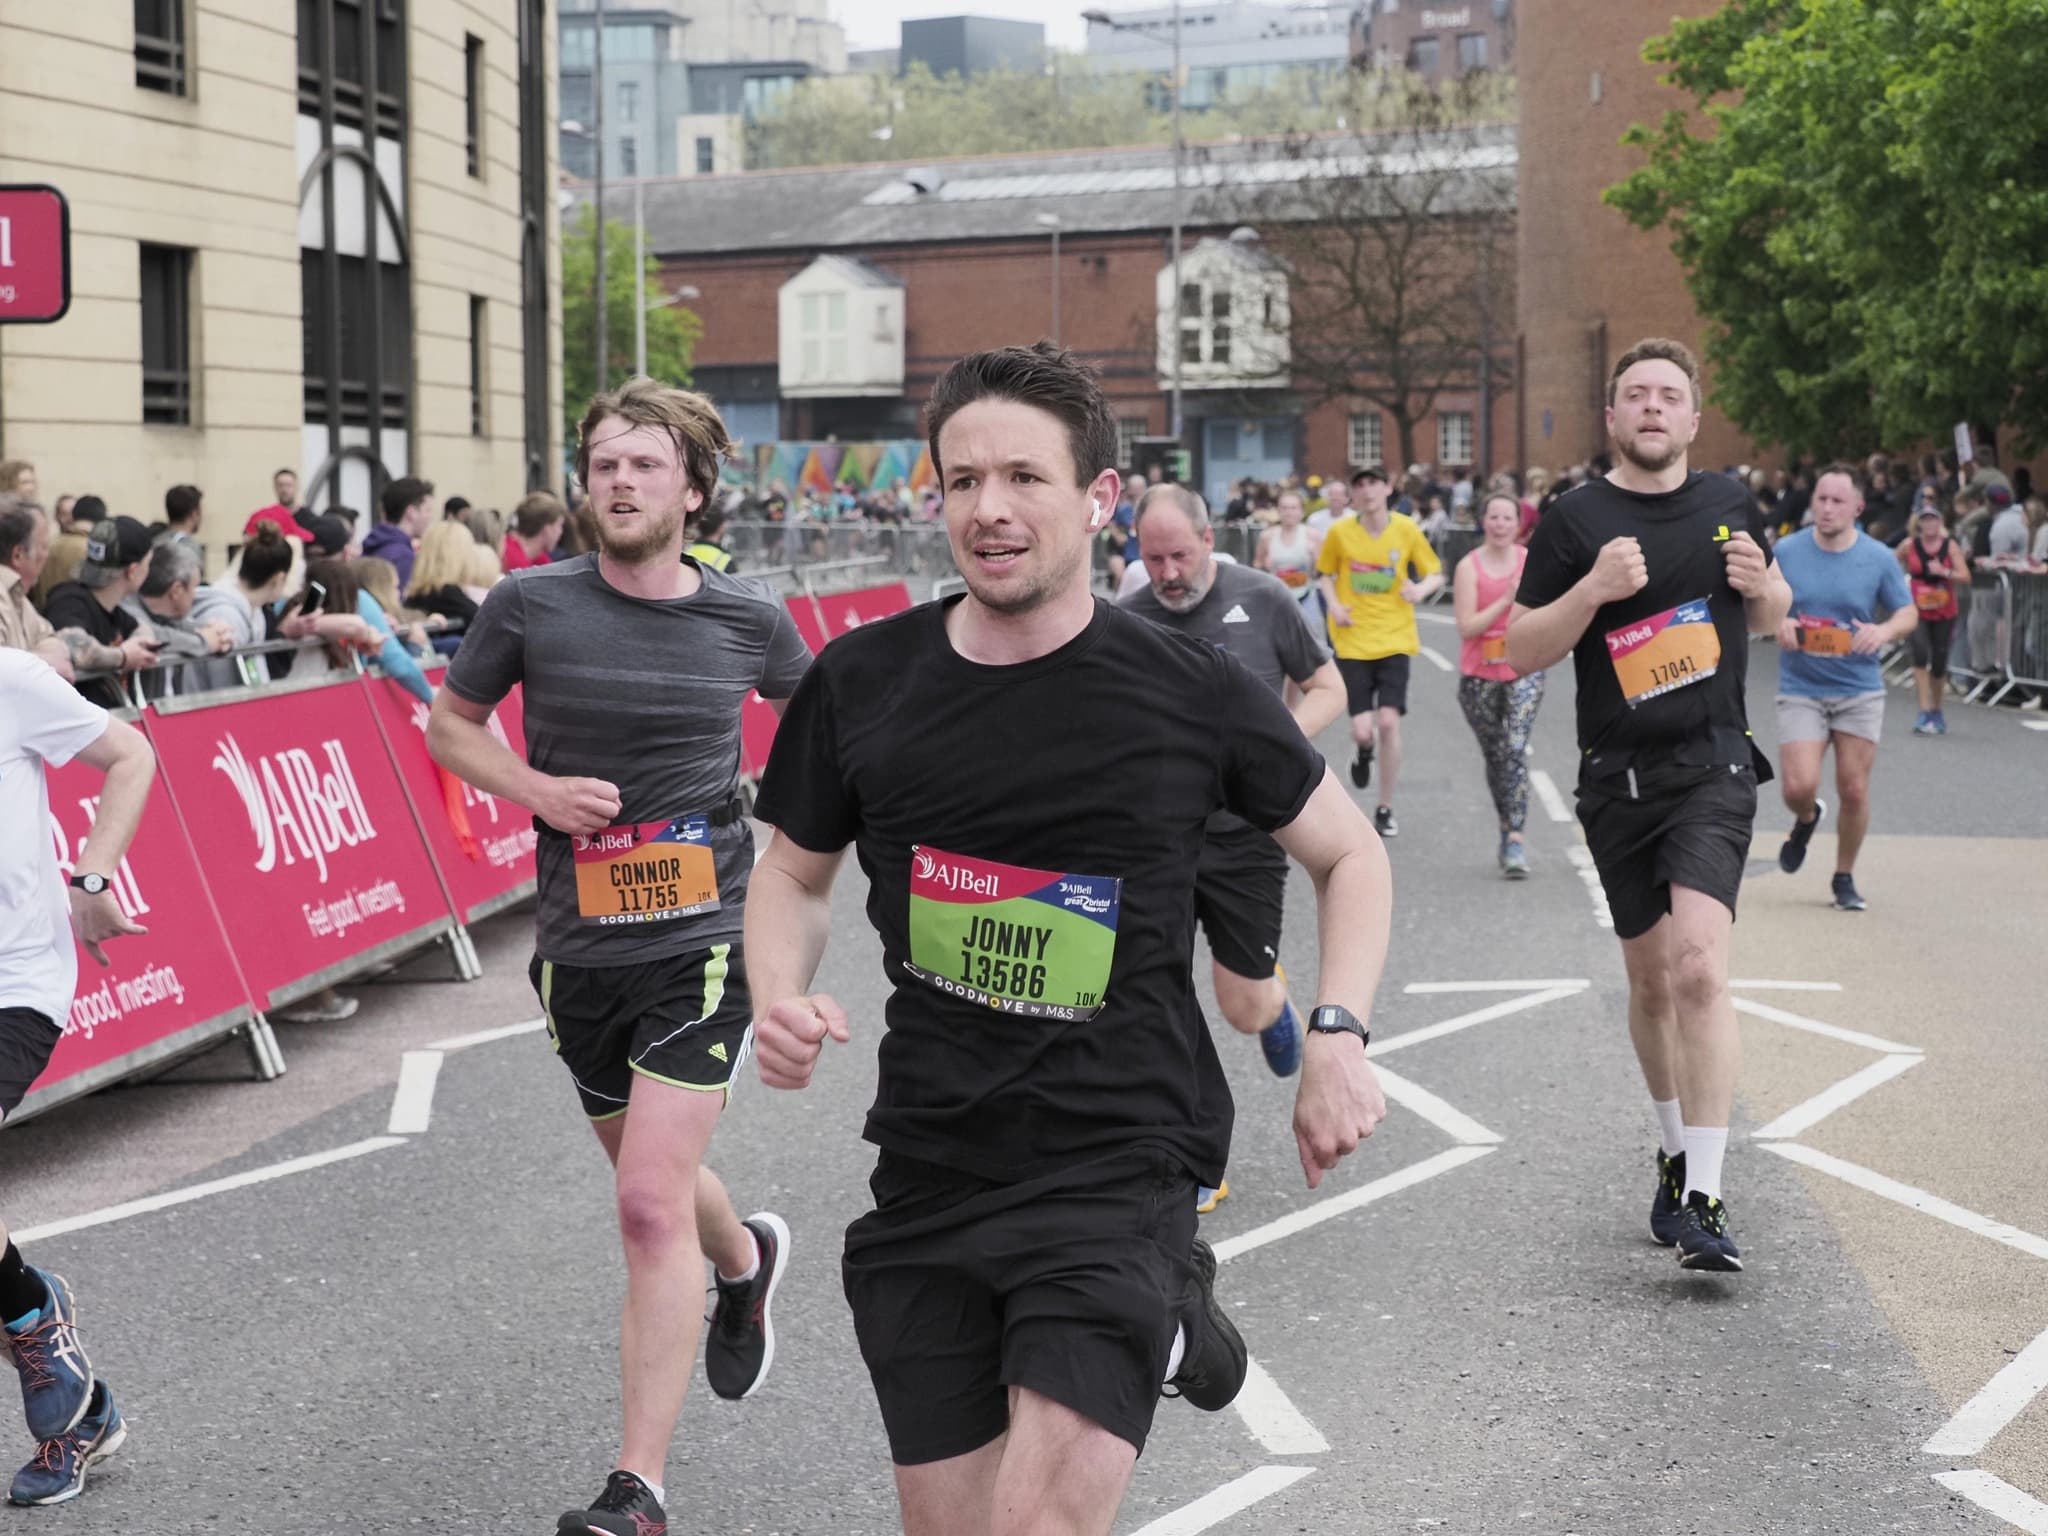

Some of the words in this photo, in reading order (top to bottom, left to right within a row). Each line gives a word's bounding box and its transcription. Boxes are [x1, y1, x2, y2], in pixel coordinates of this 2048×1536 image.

[1649, 656, 1697, 686] 17041
[610, 858, 682, 887] CONNOR
[618, 884, 678, 912] 11755
[697, 891, 712, 902] 10K
[302, 899, 335, 938] Feel
[962, 915, 1053, 961] JONNY
[960, 950, 1047, 999] 13586
[935, 976, 1025, 1013] GOODMOVE
[1031, 1005, 1041, 1015] by
[1046, 1004, 1075, 1020] M&S
[1074, 991, 1097, 1007] 10K
